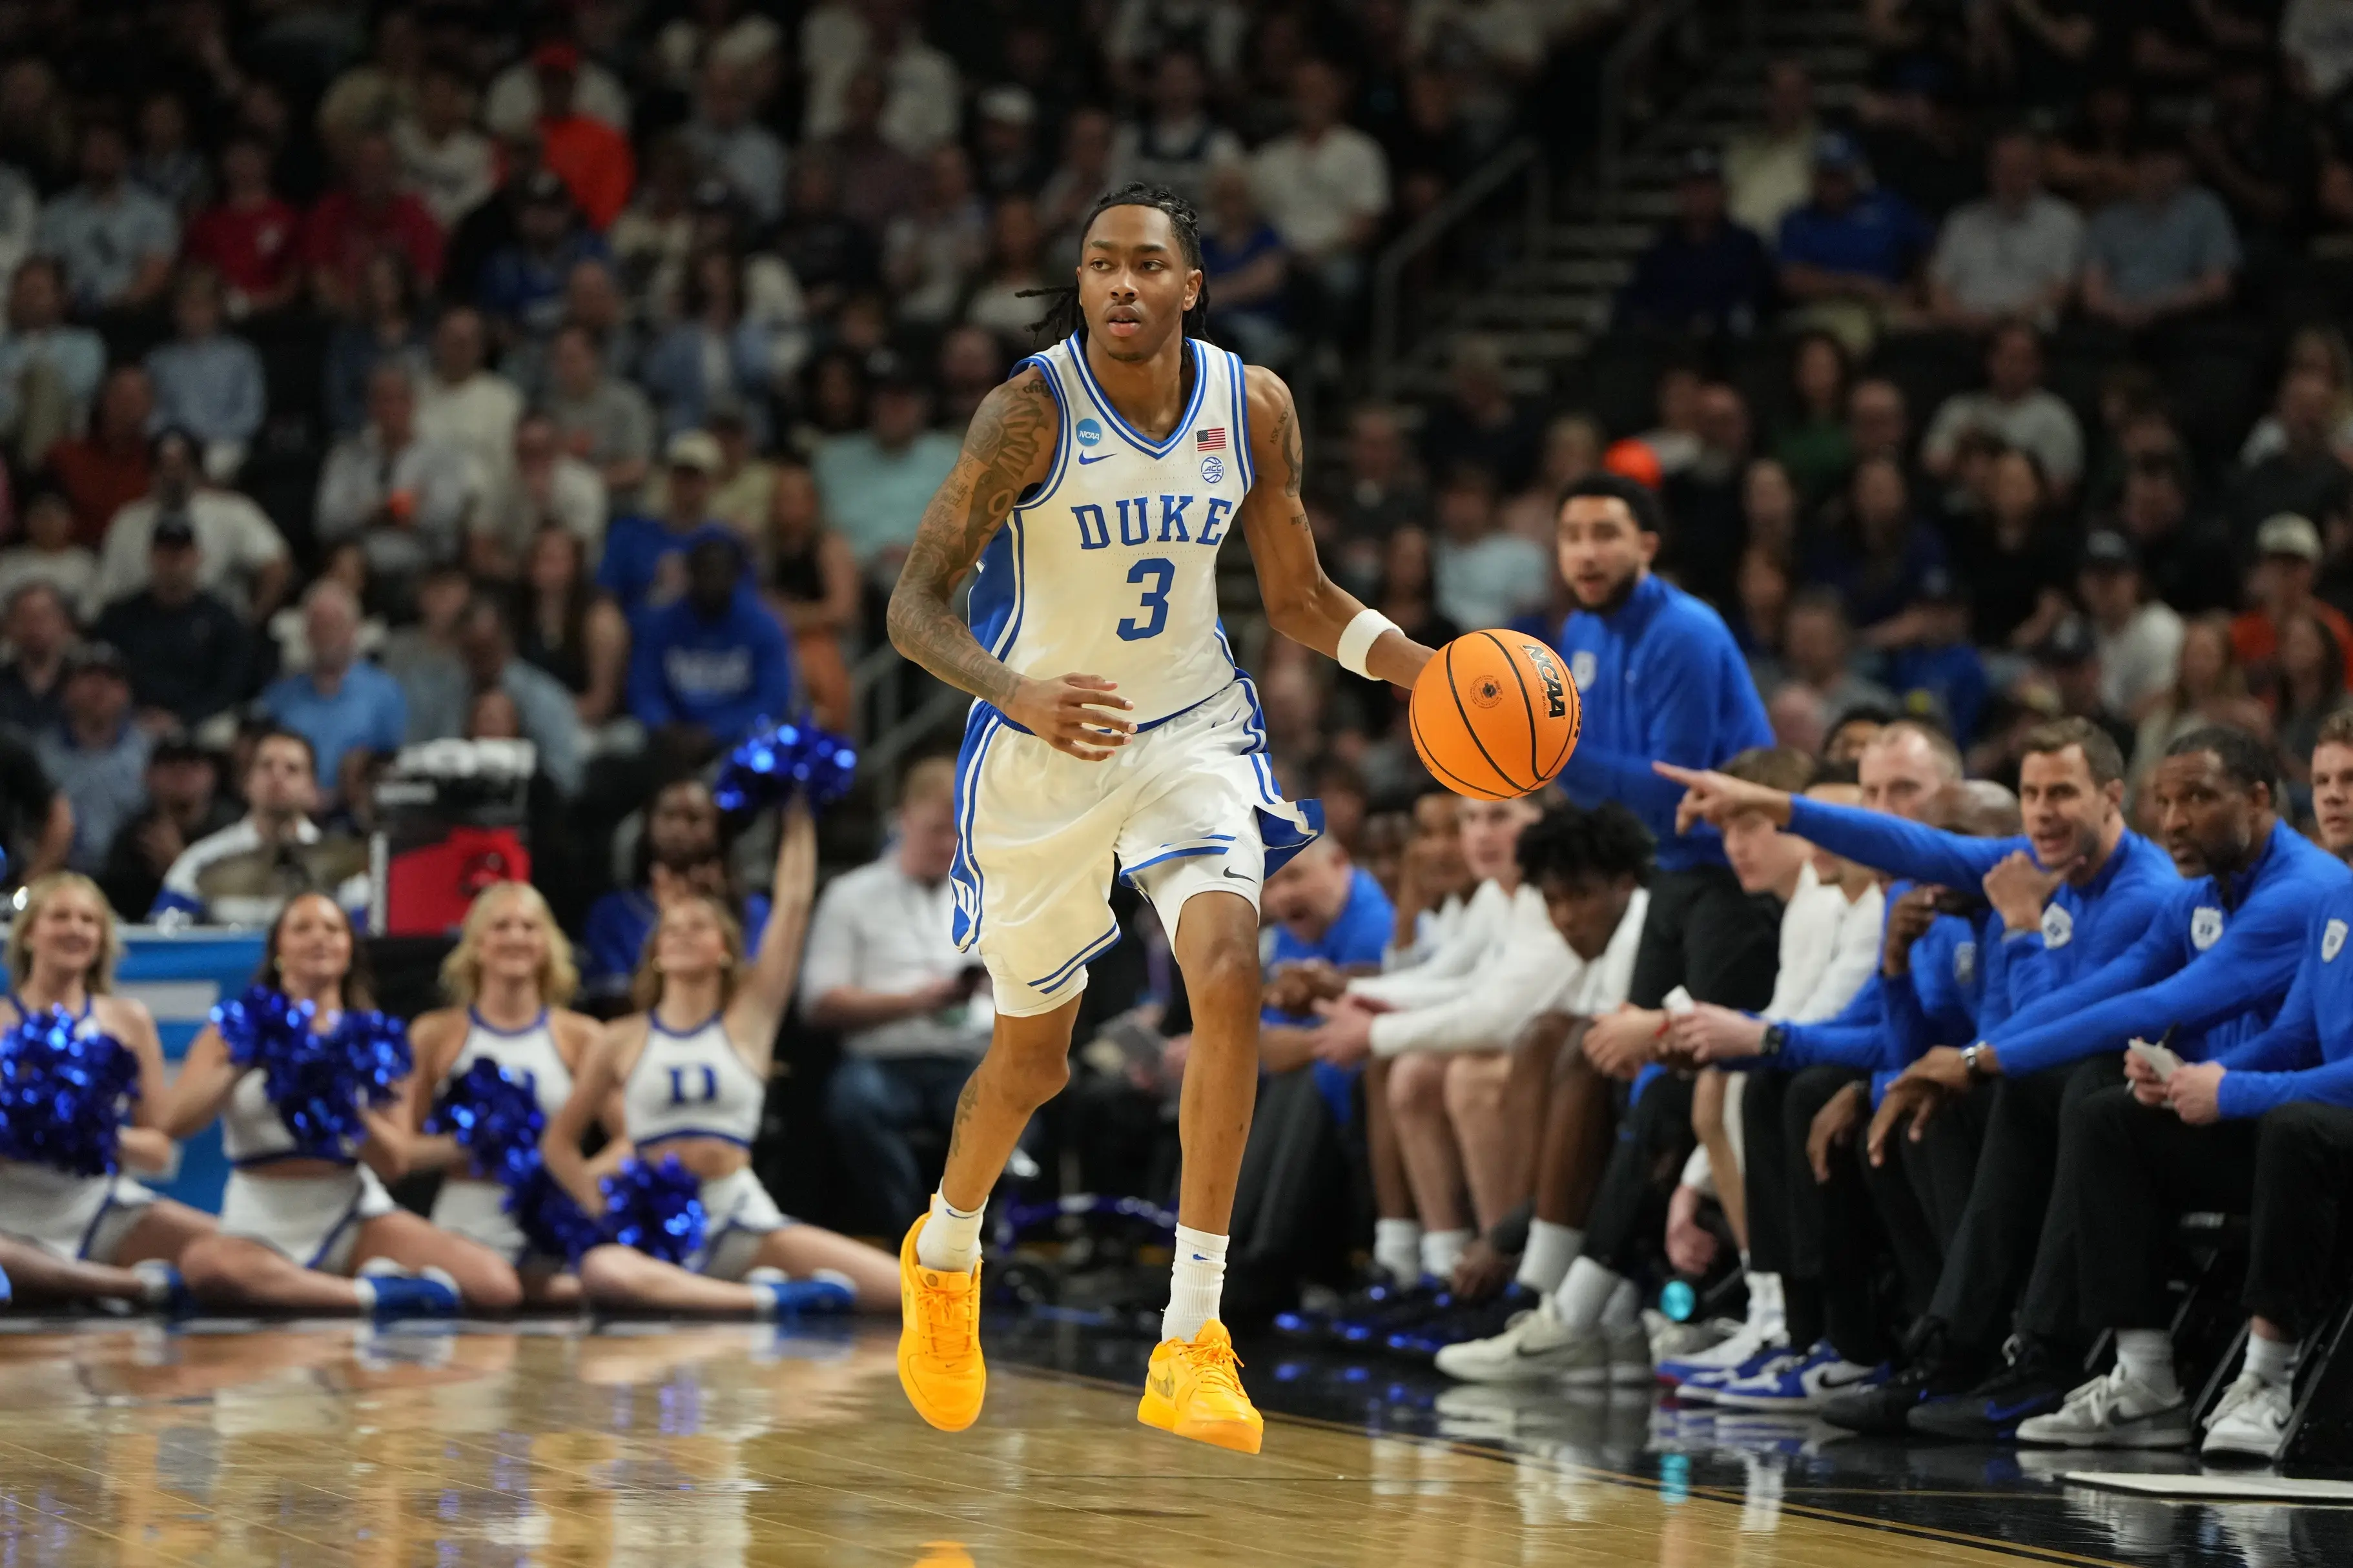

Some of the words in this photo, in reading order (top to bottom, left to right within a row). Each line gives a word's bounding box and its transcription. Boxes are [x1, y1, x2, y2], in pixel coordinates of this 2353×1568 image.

[1079, 431, 1100, 440] NCAA
[1071, 495, 1232, 549] DUKE
[1116, 558, 1175, 641] 3
[1521, 645, 1566, 718] NCAA
